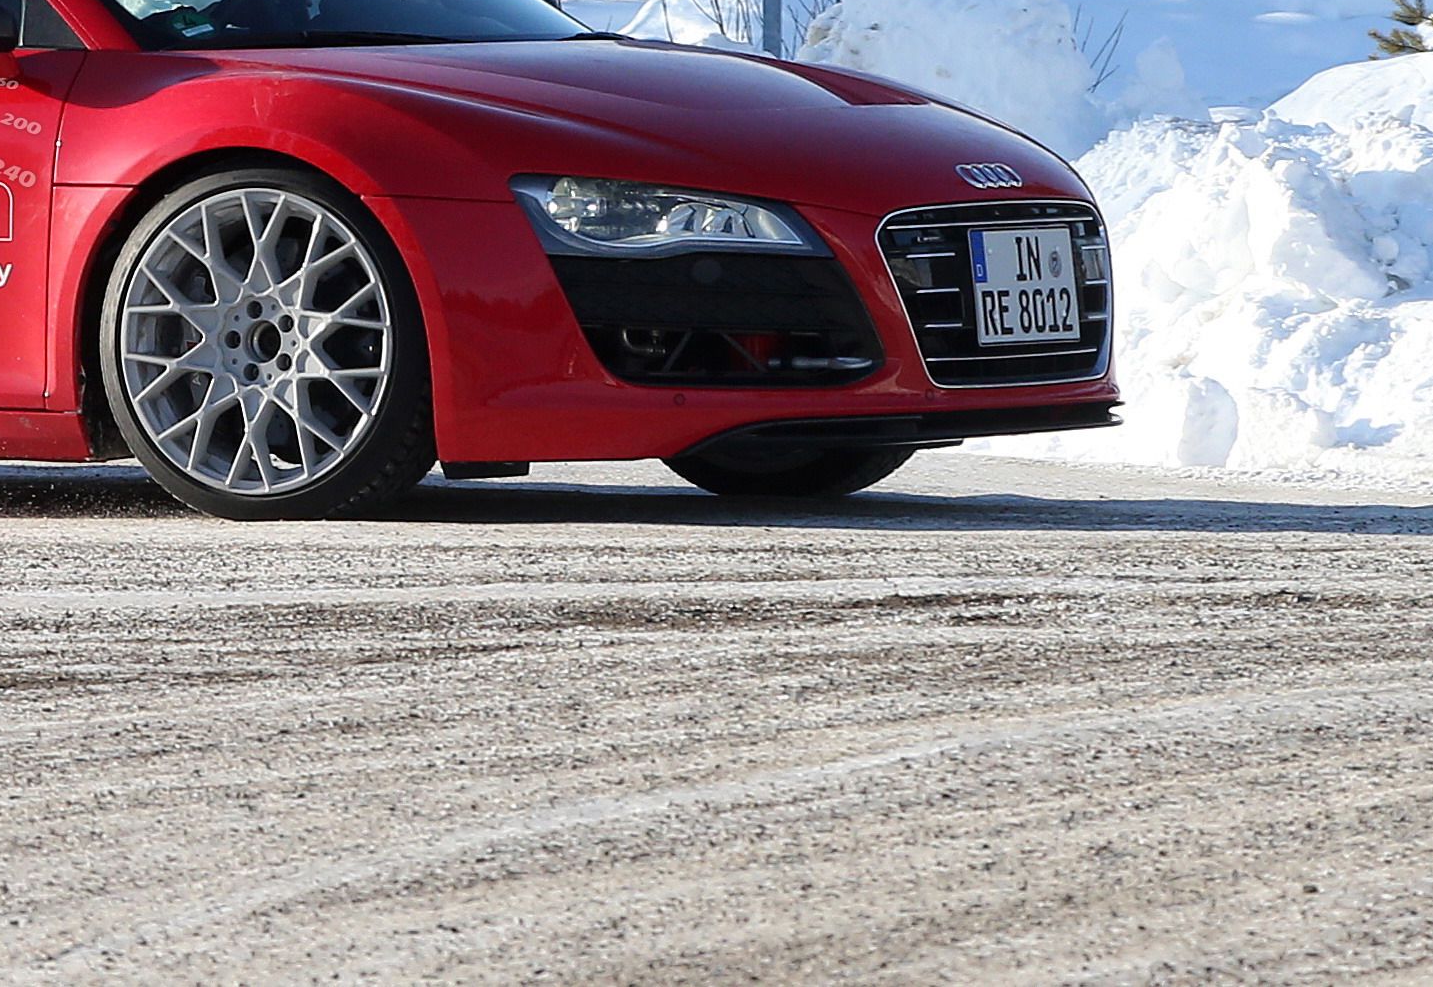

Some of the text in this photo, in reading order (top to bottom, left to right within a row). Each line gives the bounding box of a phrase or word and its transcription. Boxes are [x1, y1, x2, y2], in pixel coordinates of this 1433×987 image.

[1015, 236, 1042, 281] IN
[981, 287, 1074, 336] RE 8012
